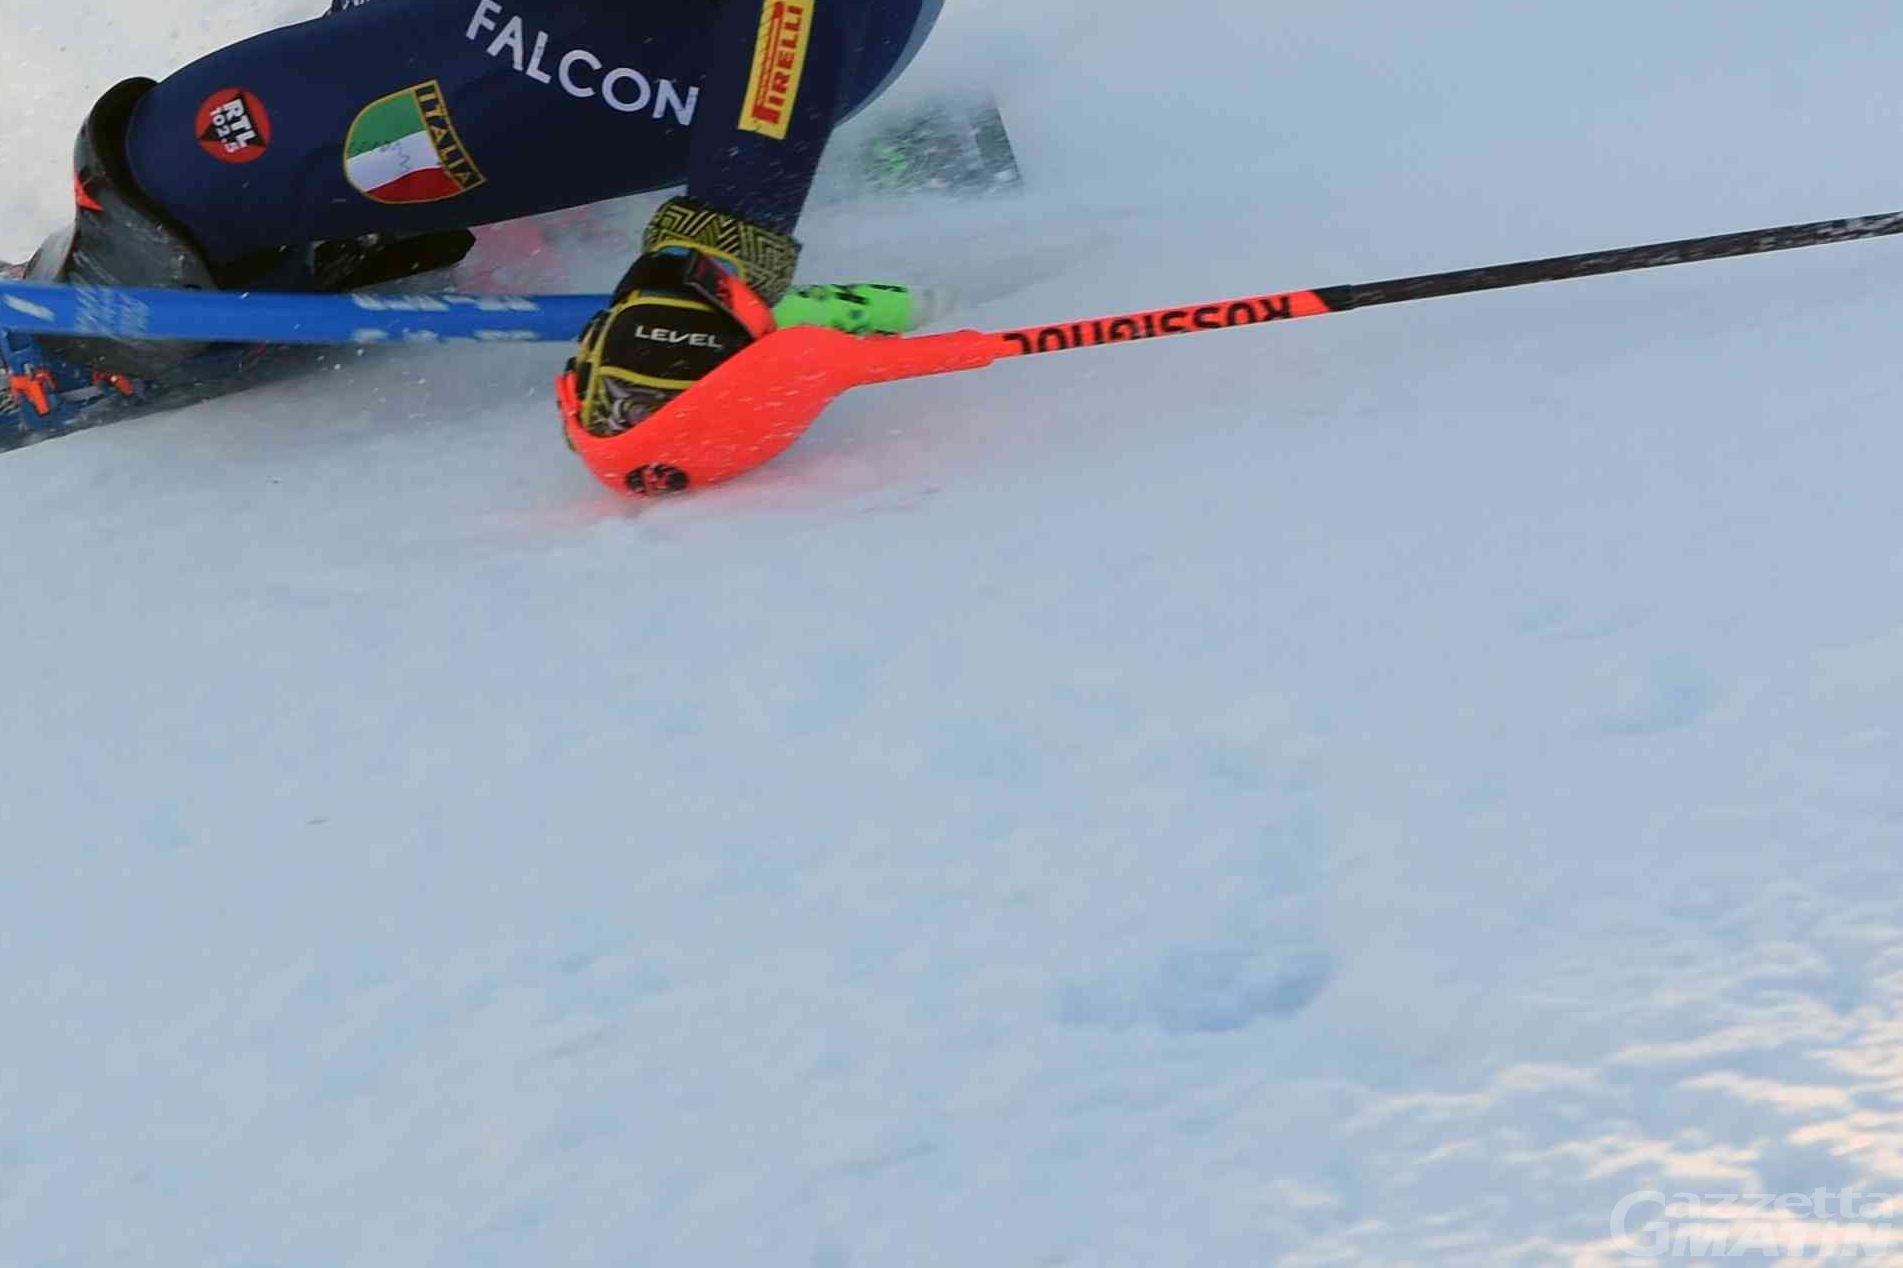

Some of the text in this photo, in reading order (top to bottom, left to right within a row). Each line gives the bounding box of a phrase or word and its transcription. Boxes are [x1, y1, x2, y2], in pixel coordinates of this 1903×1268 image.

[752, 1, 804, 124] PIRELLI
[223, 98, 256, 149] RTL
[418, 92, 473, 187] ITALIA
[634, 324, 723, 350] LEVEL
